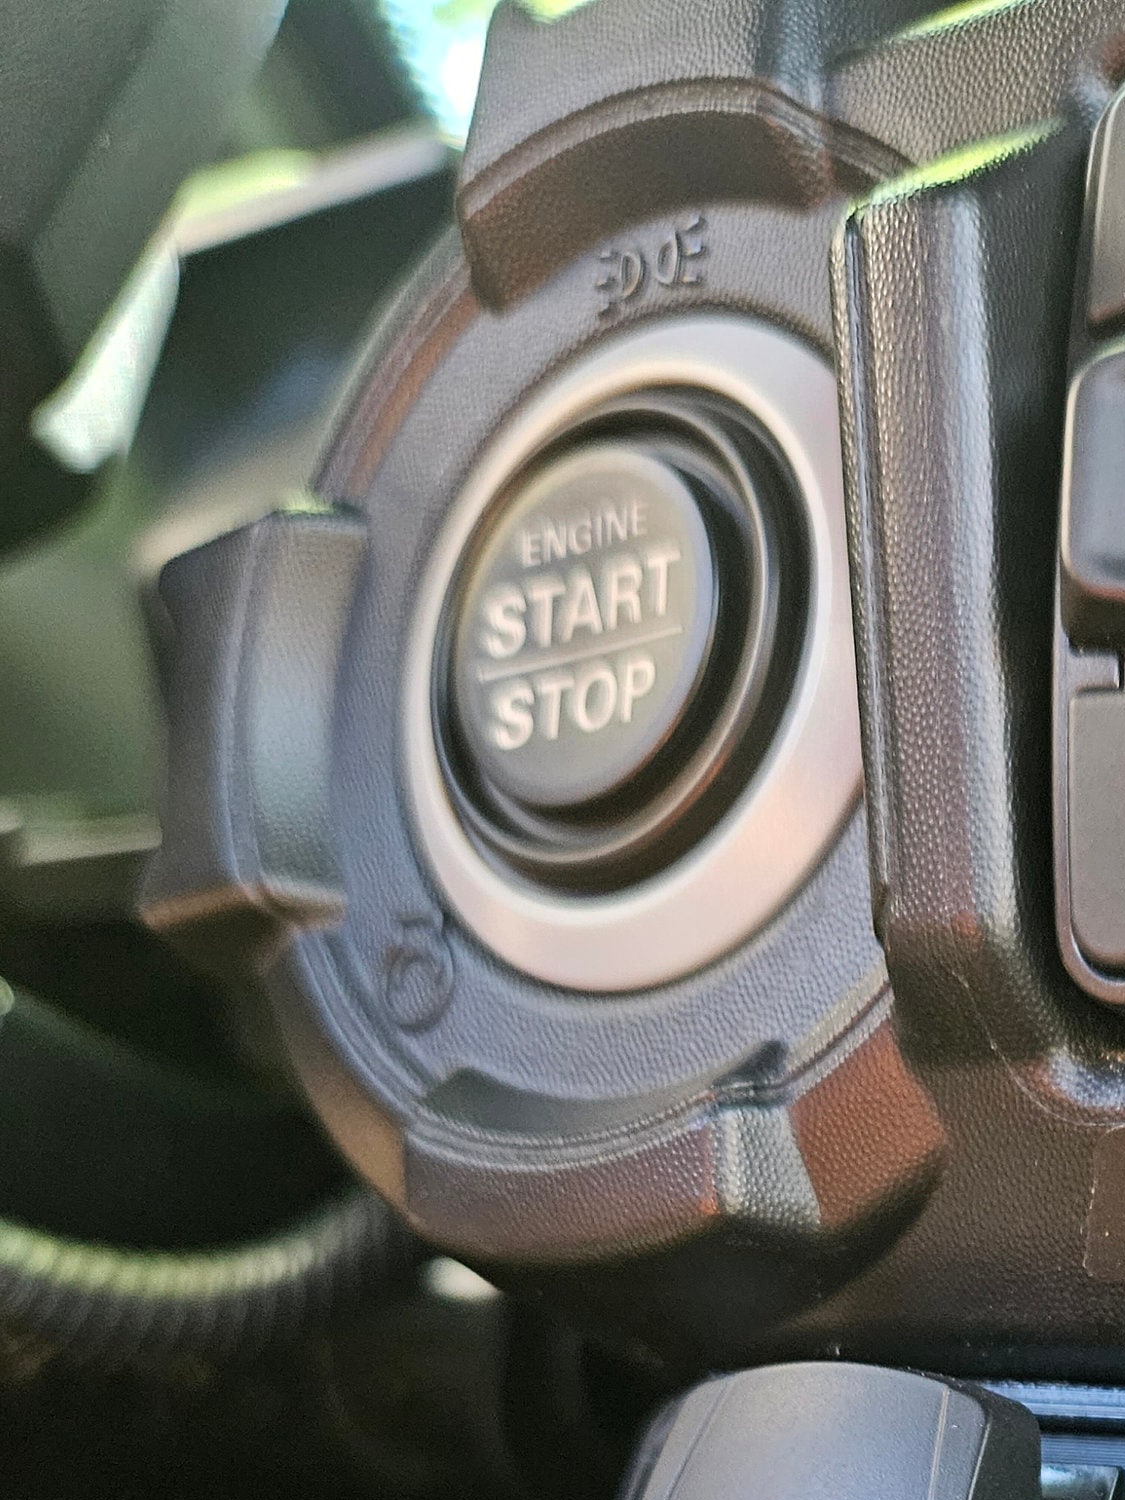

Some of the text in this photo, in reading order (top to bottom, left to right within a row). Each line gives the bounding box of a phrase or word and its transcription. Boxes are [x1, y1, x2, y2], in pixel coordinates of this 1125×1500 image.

[520, 502, 648, 569] ENGINE
[485, 551, 681, 659] START
[490, 660, 656, 753] STOP
